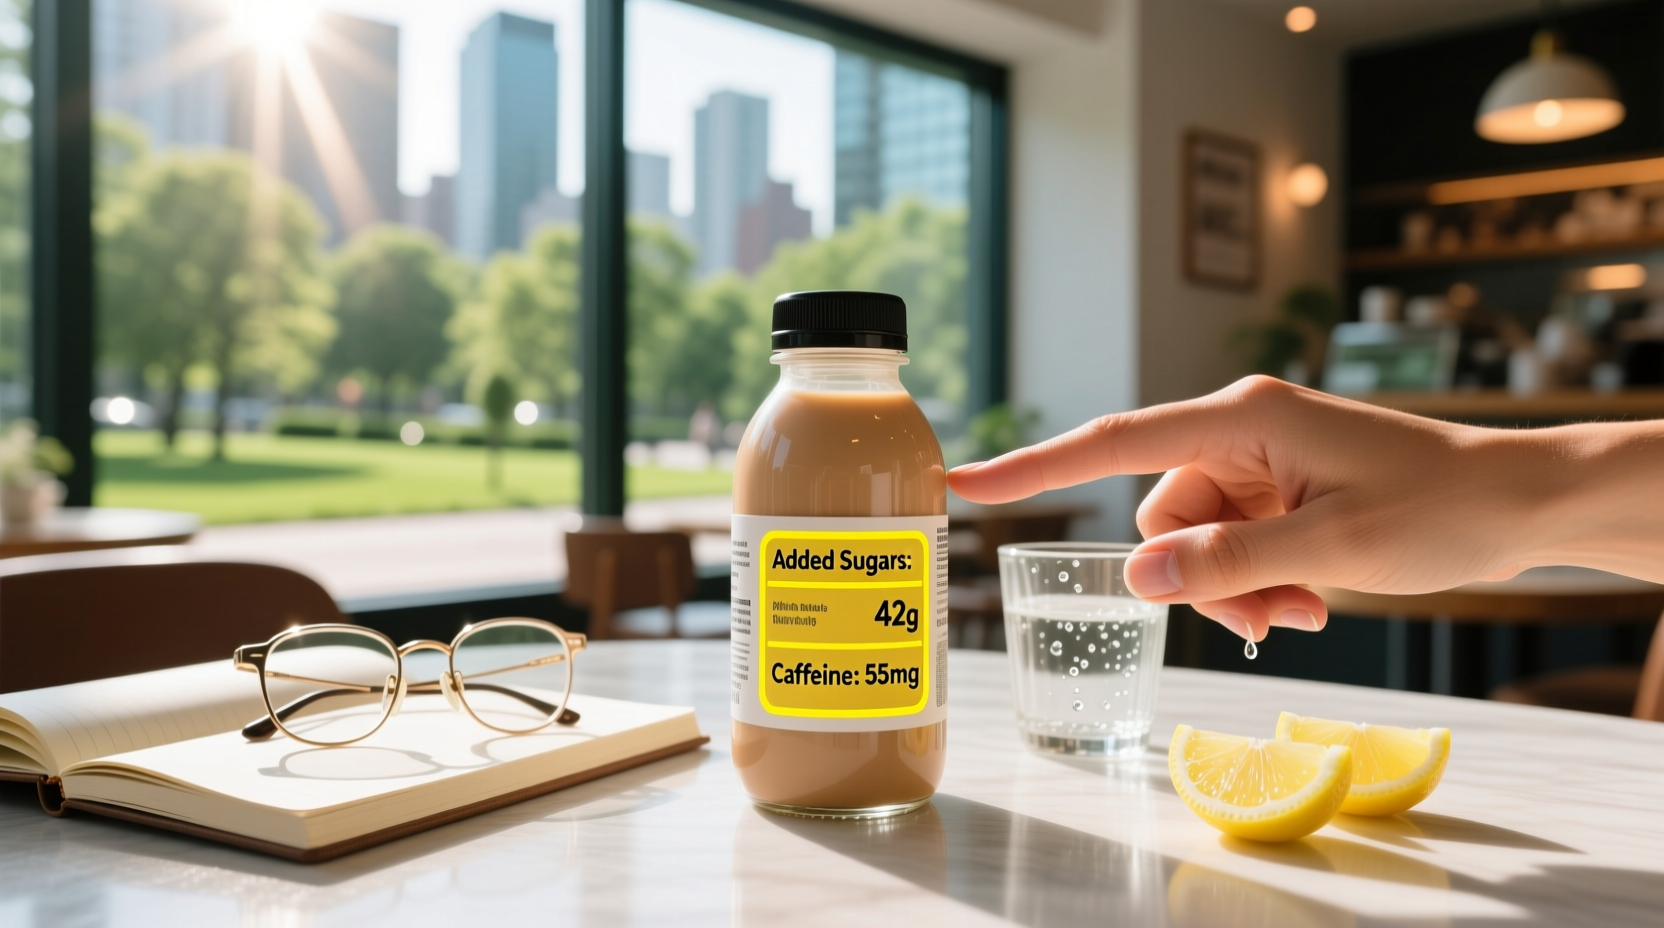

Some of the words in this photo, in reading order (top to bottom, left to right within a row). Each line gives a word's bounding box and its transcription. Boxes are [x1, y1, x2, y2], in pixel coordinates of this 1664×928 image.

[771, 548, 835, 571] Added
[840, 549, 912, 577] Sugars:
[874, 599, 919, 634] 42g
[771, 662, 860, 686] Caffeine:
[865, 662, 920, 690] 55mg
